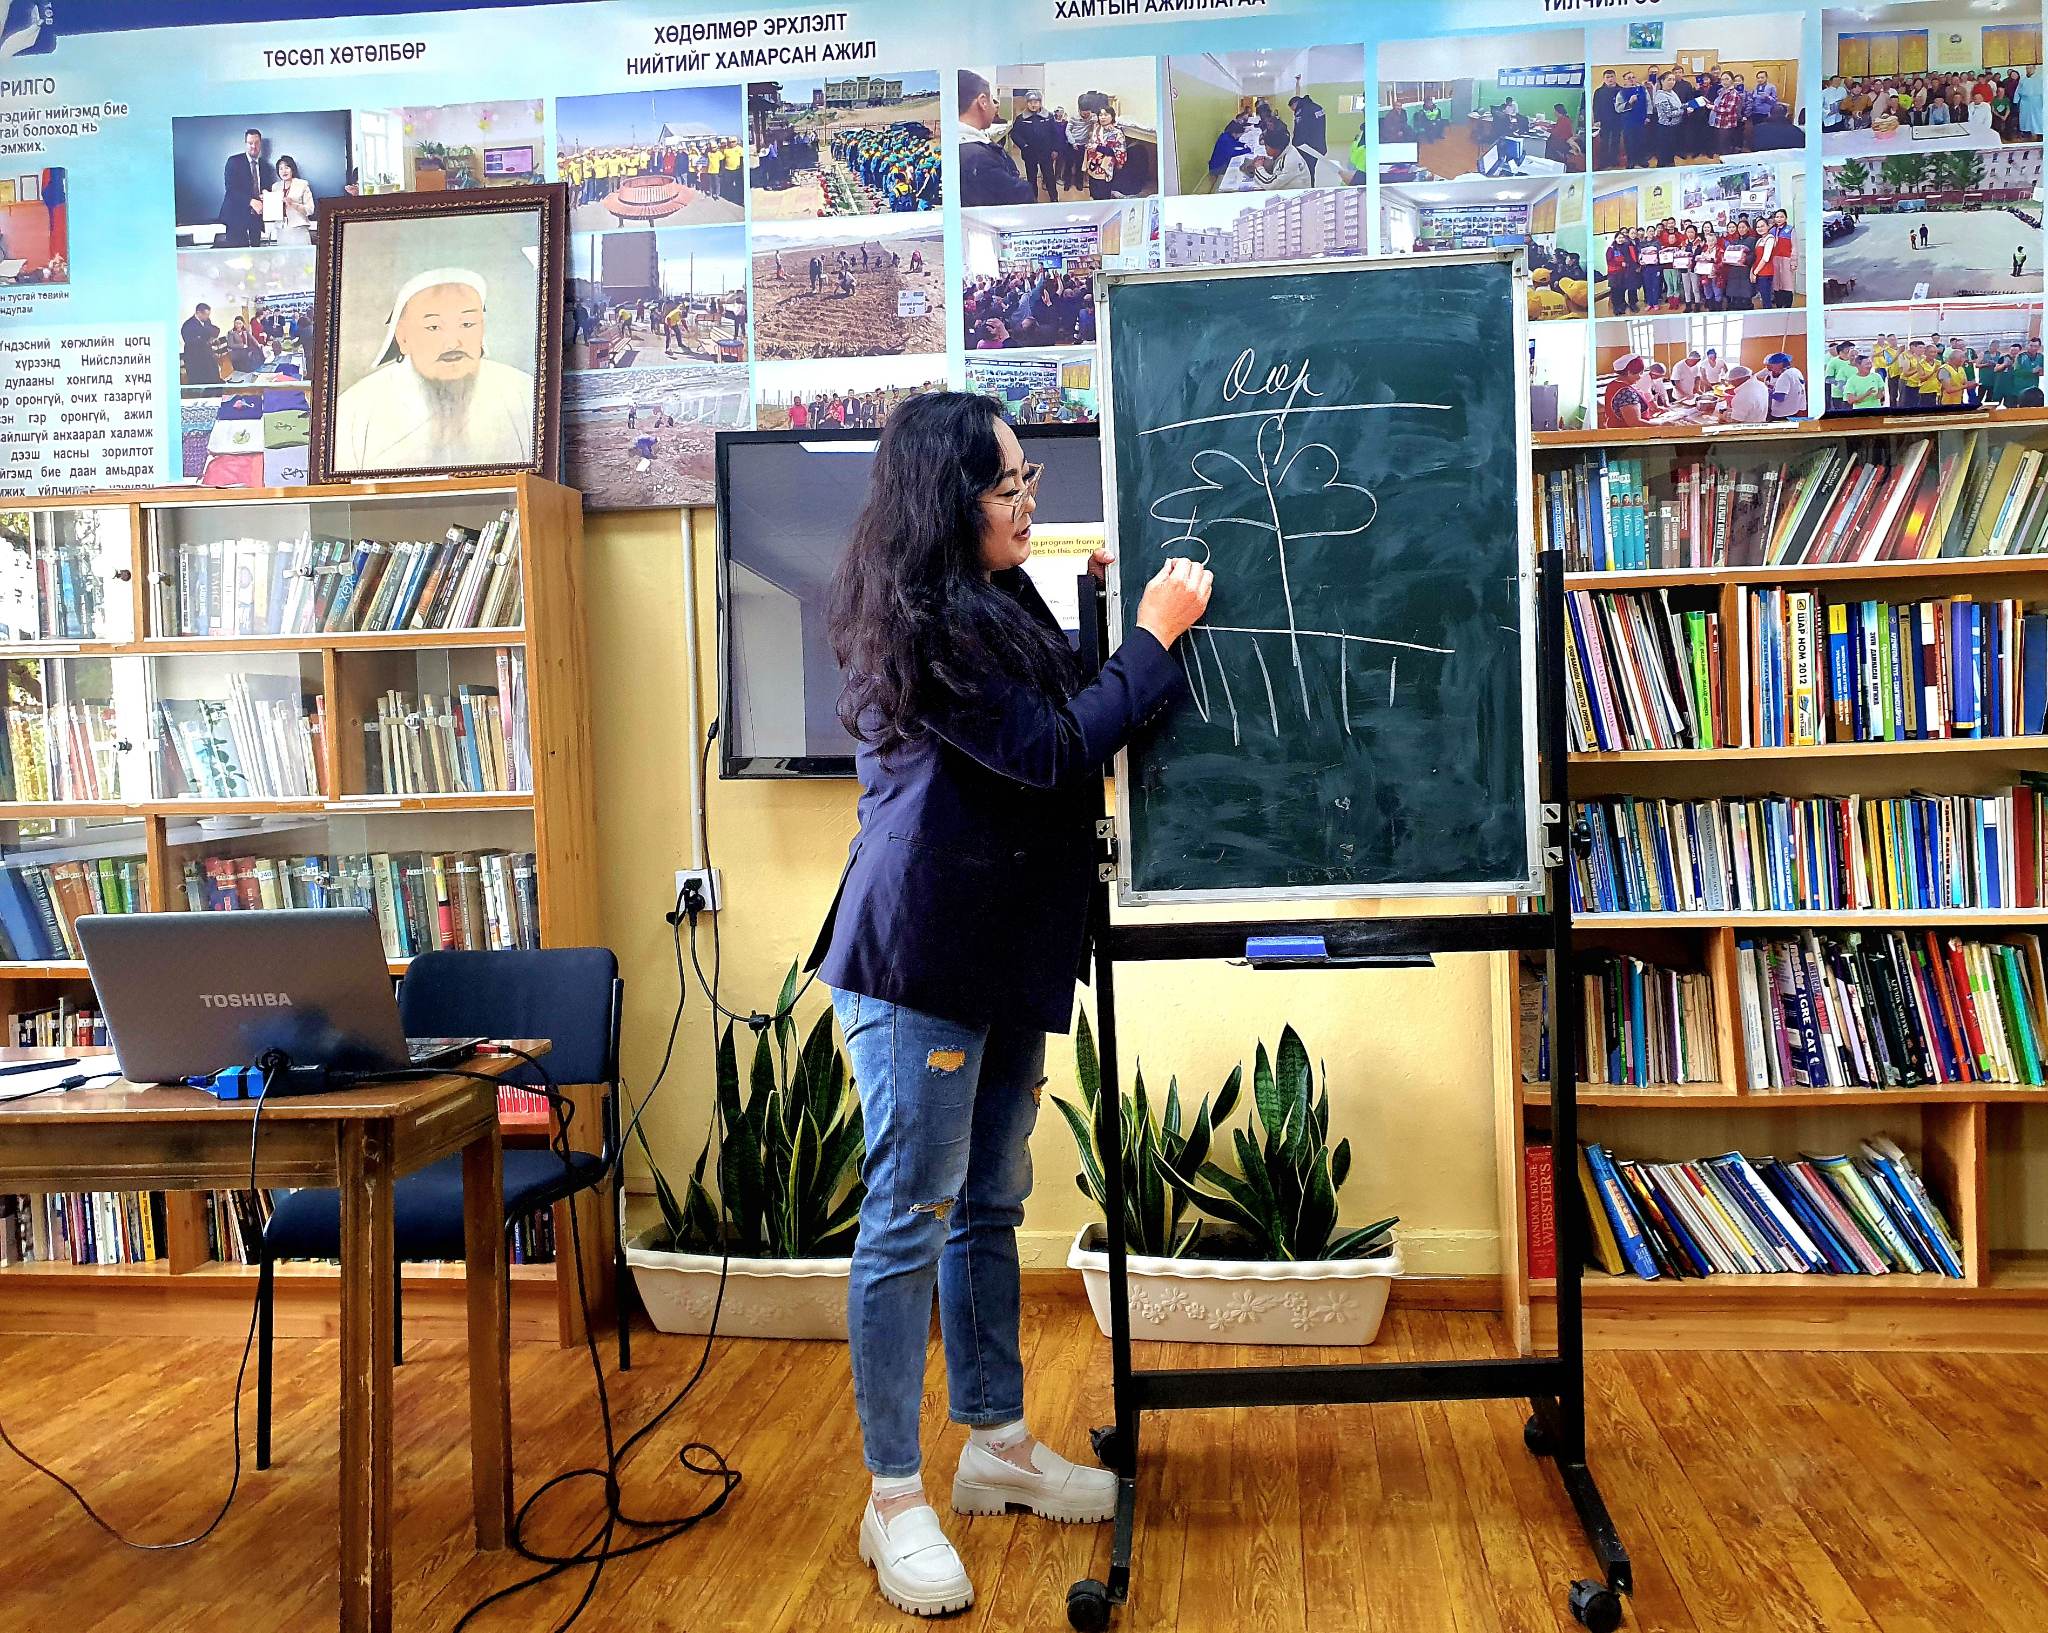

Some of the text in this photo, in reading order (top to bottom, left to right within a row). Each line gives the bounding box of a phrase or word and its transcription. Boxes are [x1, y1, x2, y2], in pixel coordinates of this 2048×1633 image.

[1055, 0, 1266, 19] ХАМТЫН АЖИЛЛ
[654, 13, 847, 45] ХӨДӨЛМӨР ЭРХЛЭЛТ
[264, 42, 426, 68] ТӨСӨЛ ХӨТӨЛБӨР
[627, 41, 876, 75] НИЙТИЙГ ХАМАРСАН АЖИЛ
[45, 103, 100, 119] нийгэмд
[104, 102, 128, 116] бие
[23, 122, 78, 137] болоход
[82, 122, 98, 132] нь
[61, 336, 115, 349] хөгжлийн
[125, 337, 151, 348] цогц
[15, 354, 151, 371] хүрээнд Нийслэлийн
[5, 373, 152, 390] дулааны хонгилд хүнд
[16, 393, 64, 407] оронгүй,
[71, 394, 97, 403] очих
[104, 391, 152, 404] газаргүй
[0, 410, 153, 425] эн гэр оронгүй, ажил
[53, 430, 105, 442] анхаарал
[111, 428, 153, 439] халамж
[11, 447, 154, 461] дээш насны зорилтот
[41, 466, 61, 478] бие
[70, 467, 96, 478] даан
[106, 465, 154, 477] амьдрах
[1797, 613, 1807, 684] ШАР НОМ 2012
[199, 992, 294, 1008] TOSHIBA
[1799, 998, 1812, 1026] GRE
[1804, 1028, 1817, 1054] CAT
[1540, 1163, 1553, 1245] WEBSTER'S
[1530, 1200, 1540, 1248] RANDOM
